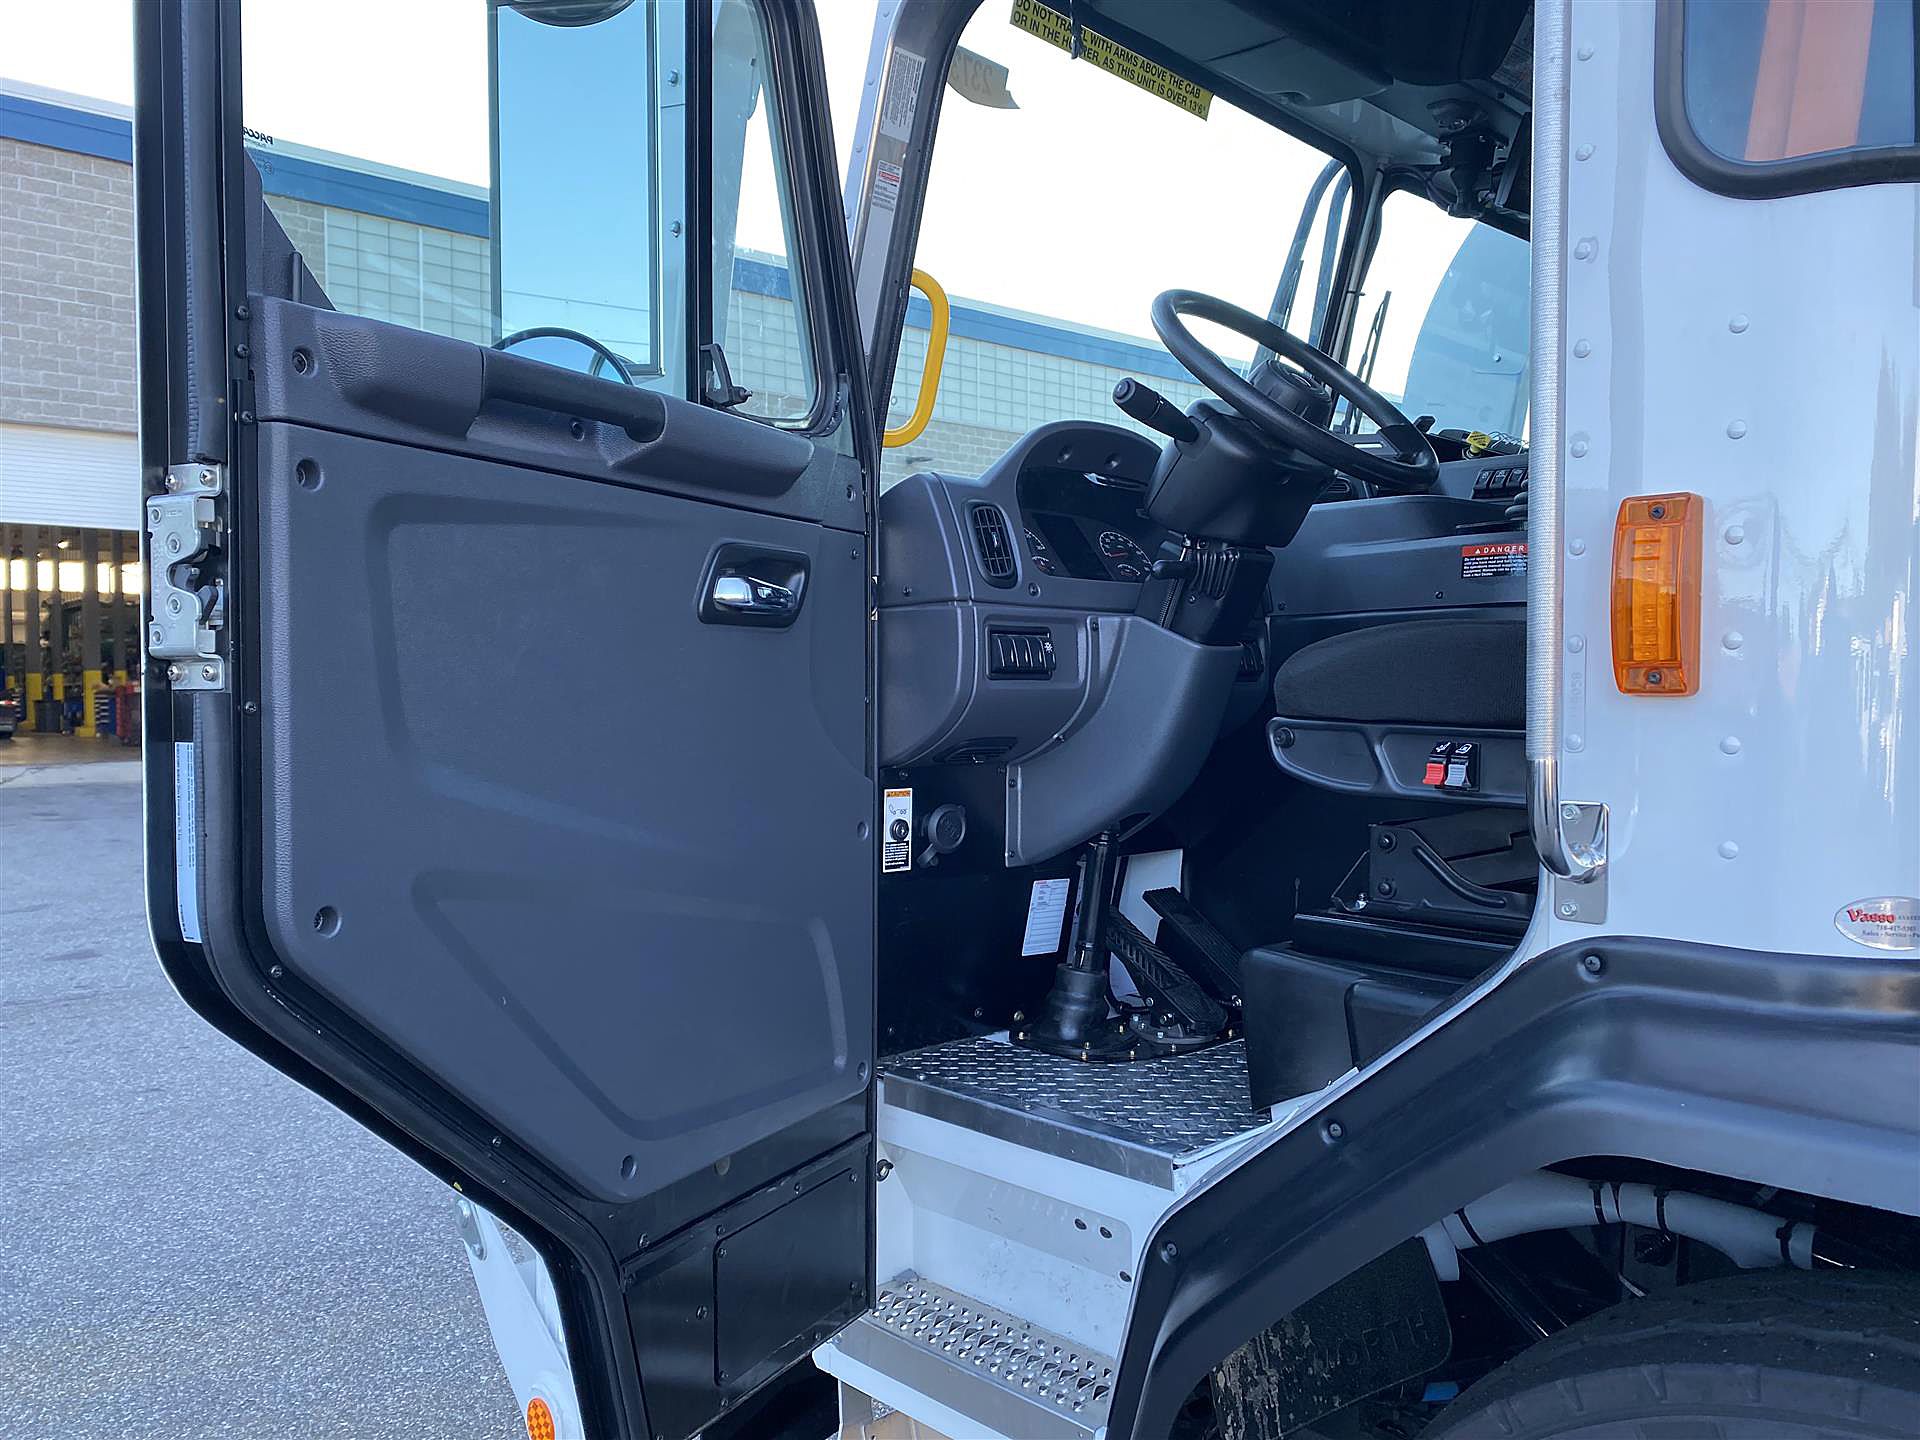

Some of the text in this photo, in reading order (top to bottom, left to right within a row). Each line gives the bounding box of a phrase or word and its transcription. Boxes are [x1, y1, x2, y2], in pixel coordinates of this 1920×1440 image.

[1013, 10, 1028, 27] OR
[1029, 20, 1040, 33] IN
[1043, 24, 1061, 43] THE
[1102, 56, 1115, 70] AS
[1117, 62, 1136, 80] THIS
[1136, 71, 1156, 91] UNIT
[1157, 82, 1166, 96] IS
[1166, 87, 1188, 107] OVER
[1016, 0, 1201, 99] DO NOT TRAL WITH ARMS ABOVE THE CAB
[1483, 545, 1525, 554] DANGER
